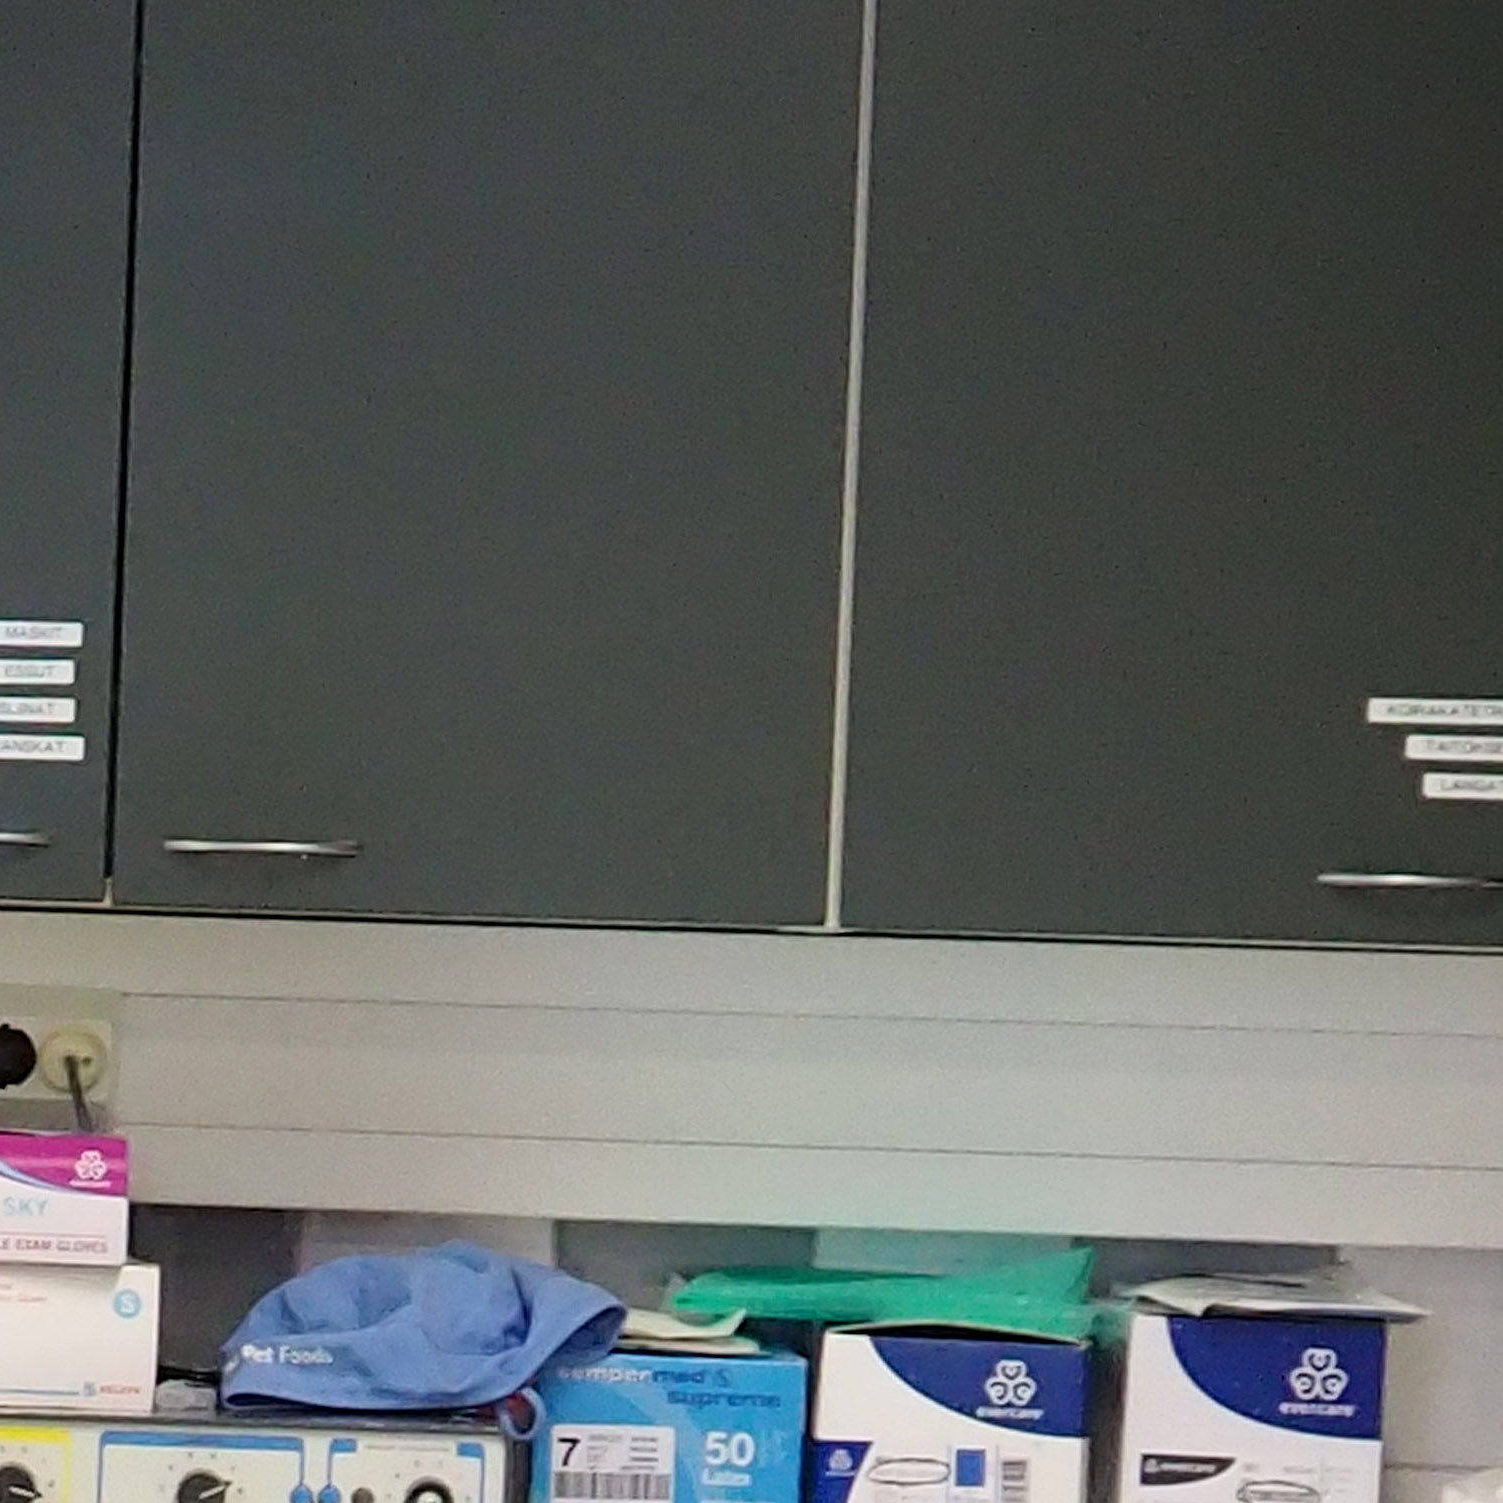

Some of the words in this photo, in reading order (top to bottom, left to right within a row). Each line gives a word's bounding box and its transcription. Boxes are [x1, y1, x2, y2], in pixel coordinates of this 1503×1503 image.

[3, 1197, 50, 1217] SKY
[120, 1293, 136, 1314] S
[557, 1436, 582, 1467] 7
[704, 1430, 756, 1467] 50
